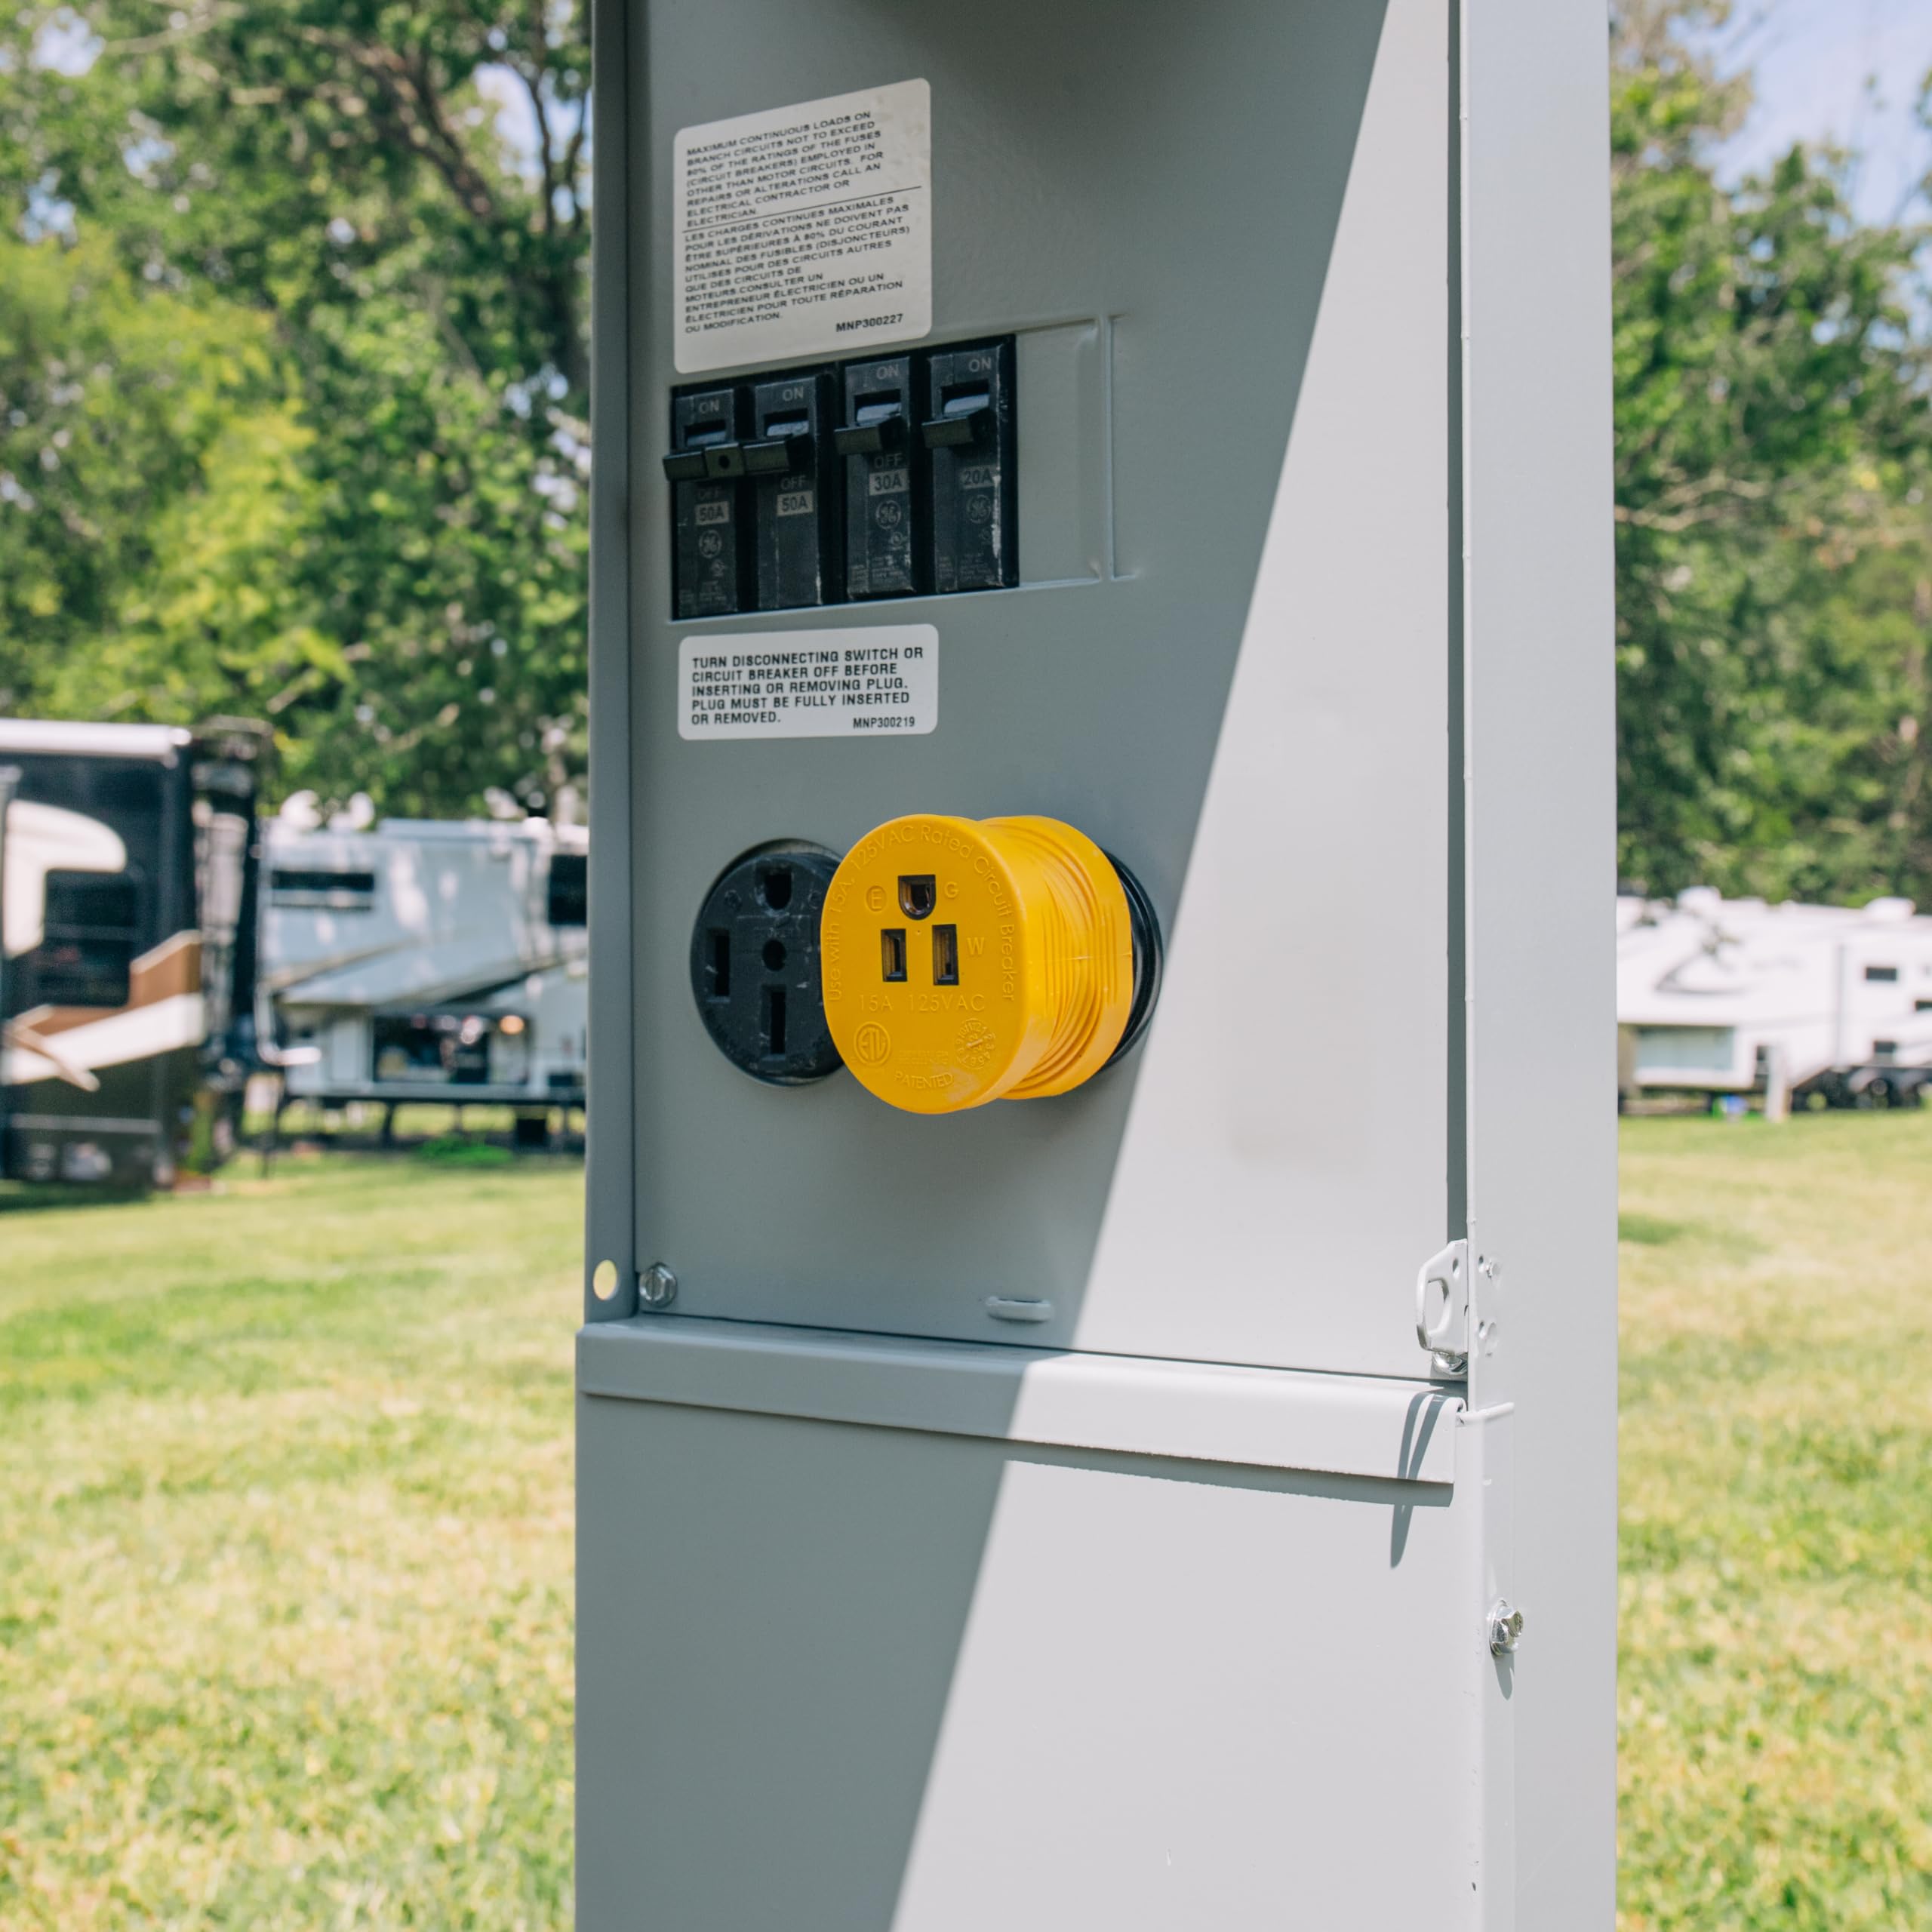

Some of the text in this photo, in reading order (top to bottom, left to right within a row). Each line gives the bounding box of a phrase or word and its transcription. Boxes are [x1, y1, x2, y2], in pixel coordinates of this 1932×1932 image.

[686, 111, 870, 155] MAXIMUM CONTINUOUS LOADS ON
[687, 152, 730, 166] BRANCH
[734, 140, 783, 155] CIRCUITS
[786, 134, 808, 144] NOT
[830, 121, 875, 136] EXCEED
[728, 158, 746, 167] THE
[752, 147, 798, 162] RATINGS
[801, 143, 815, 152] OF
[820, 138, 840, 148] THE
[844, 130, 881, 143] FUSES
[686, 183, 721, 196] OTHER
[726, 178, 753, 188] THAN
[757, 169, 795, 182] MOTOR
[860, 151, 883, 162] FOR
[687, 142, 875, 187] (CIRCUIT BREAKERS) EMPLOYED IN
[686, 162, 880, 206] REPAIRS OR ALTERATIONS CALL AN
[687, 179, 849, 217] ELECTRICAL CONTRACTOR OR
[685, 196, 894, 242] LES CHARGES CONTINUES MAXIMALES
[685, 241, 713, 251] POUR
[718, 236, 737, 245] LES
[834, 209, 881, 224] DOIVENT
[886, 203, 909, 214] PAS
[829, 227, 844, 235] DU
[848, 216, 903, 232] COURANT
[685, 226, 909, 272] NOMINAL DES FUSIBLES (DISJONCTEURS)
[734, 263, 764, 272] POUR
[768, 258, 788, 267] DES
[792, 248, 843, 263] CIRCUITS
[846, 239, 891, 254] AUTRES
[685, 266, 801, 292] QUE DES CIRCUITS DE
[808, 272, 823, 281] UN
[685, 292, 770, 312] ENTREPRENEUR
[848, 275, 865, 285] OU
[867, 272, 884, 281] UN
[757, 300, 786, 310] POUR
[791, 293, 826, 305] TOUTE
[835, 312, 903, 332] MNP300227
[876, 364, 899, 380] ON
[968, 357, 992, 373] ON
[782, 386, 804, 401] ON
[699, 399, 719, 414] ON
[873, 454, 904, 469] OFF
[780, 475, 806, 490] OFF
[874, 474, 902, 491] 30A
[963, 469, 992, 486] 20A
[699, 505, 725, 521] 50A
[781, 495, 809, 512] 50A
[692, 647, 923, 669] TURN DISCONNECTING SWITCH OR
[692, 663, 897, 683] CIRCUIT BREAKER OFF BEFORE
[692, 678, 908, 697] INSERTING OR REMOVING PLUG.
[692, 692, 909, 711] PLUG MUST BE FULLY INSERTED
[691, 712, 781, 725] OR REMOVED.
[853, 717, 915, 729] MNP300219
[851, 825, 915, 871] 125VAC
[920, 825, 974, 858] Rated
[943, 881, 960, 899] G
[973, 856, 1015, 918] Circuit
[827, 922, 840, 963] with
[966, 937, 986, 955] W
[1001, 924, 1015, 1001] Breaker
[827, 966, 841, 1002] Use
[858, 993, 985, 1012] 15A 125VAC
[894, 1069, 954, 1089] PATENTED
